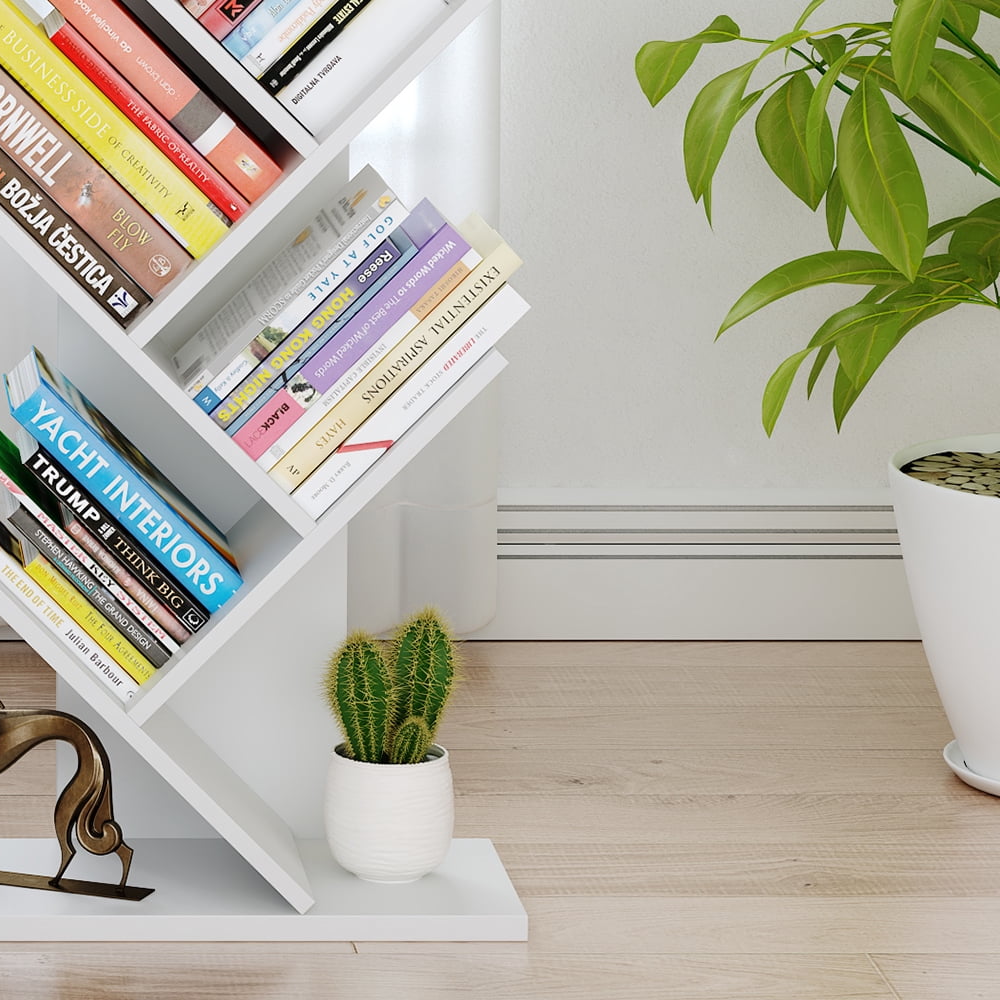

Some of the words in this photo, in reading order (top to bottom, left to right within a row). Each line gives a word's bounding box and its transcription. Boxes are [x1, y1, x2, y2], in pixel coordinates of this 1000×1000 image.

[332, 2, 354, 24] ESTATE
[118, 40, 132, 54] da
[133, 55, 160, 81] brown
[156, 77, 176, 97] dan
[291, 76, 320, 105] DIGITALNA
[0, 28, 79, 104] BUSINESS
[69, 96, 113, 139] SIDE
[106, 134, 122, 151] OF
[118, 147, 173, 199] CREATIVITY
[125, 99, 144, 117] THE
[140, 115, 170, 144] FABRIC
[167, 141, 181, 155] OF
[177, 152, 210, 183] REALITY
[105, 227, 133, 255] FLY
[110, 206, 154, 249] BLOW
[359, 214, 394, 248] GOLF
[44, 221, 121, 296] ČESTICA
[340, 249, 358, 268] AT
[355, 249, 392, 285] Reese
[426, 238, 456, 268] Wicked
[306, 269, 339, 301] YALE
[404, 263, 431, 290] Words
[309, 286, 355, 330] HONG
[368, 307, 387, 325] Best
[383, 294, 400, 311] The
[427, 265, 501, 337] EXISTENTIAL
[335, 329, 364, 358] Wicked
[359, 321, 372, 335] of
[268, 326, 314, 371] KONG
[352, 343, 386, 376] INVISIBLE
[313, 353, 340, 379] Words
[359, 334, 431, 404] ASPIRATIONS
[215, 367, 273, 423] NIGHTS
[321, 374, 355, 406] CAPITALISM
[260, 402, 289, 431] BLACK
[314, 418, 346, 449] HAYES
[24, 398, 111, 482] YACHT
[98, 473, 229, 598] INTERIORS
[27, 452, 104, 526] TRUMP
[33, 528, 64, 558] STEPHEN
[59, 555, 95, 590] HAWKING
[90, 589, 107, 605] THE
[102, 601, 129, 627] GRAND
[125, 624, 152, 650] DESIGN
[35, 511, 90, 563] MASTER
[88, 563, 115, 589] KEY
[114, 589, 168, 640] SYSTEM
[110, 536, 161, 584] THINK
[156, 581, 185, 609] BIG
[0, 565, 19, 583] THE
[14, 578, 35, 598] END
[30, 594, 45, 609] OF
[42, 606, 64, 628] TIME
[64, 628, 91, 655] Julian
[88, 652, 125, 687] Barbour
